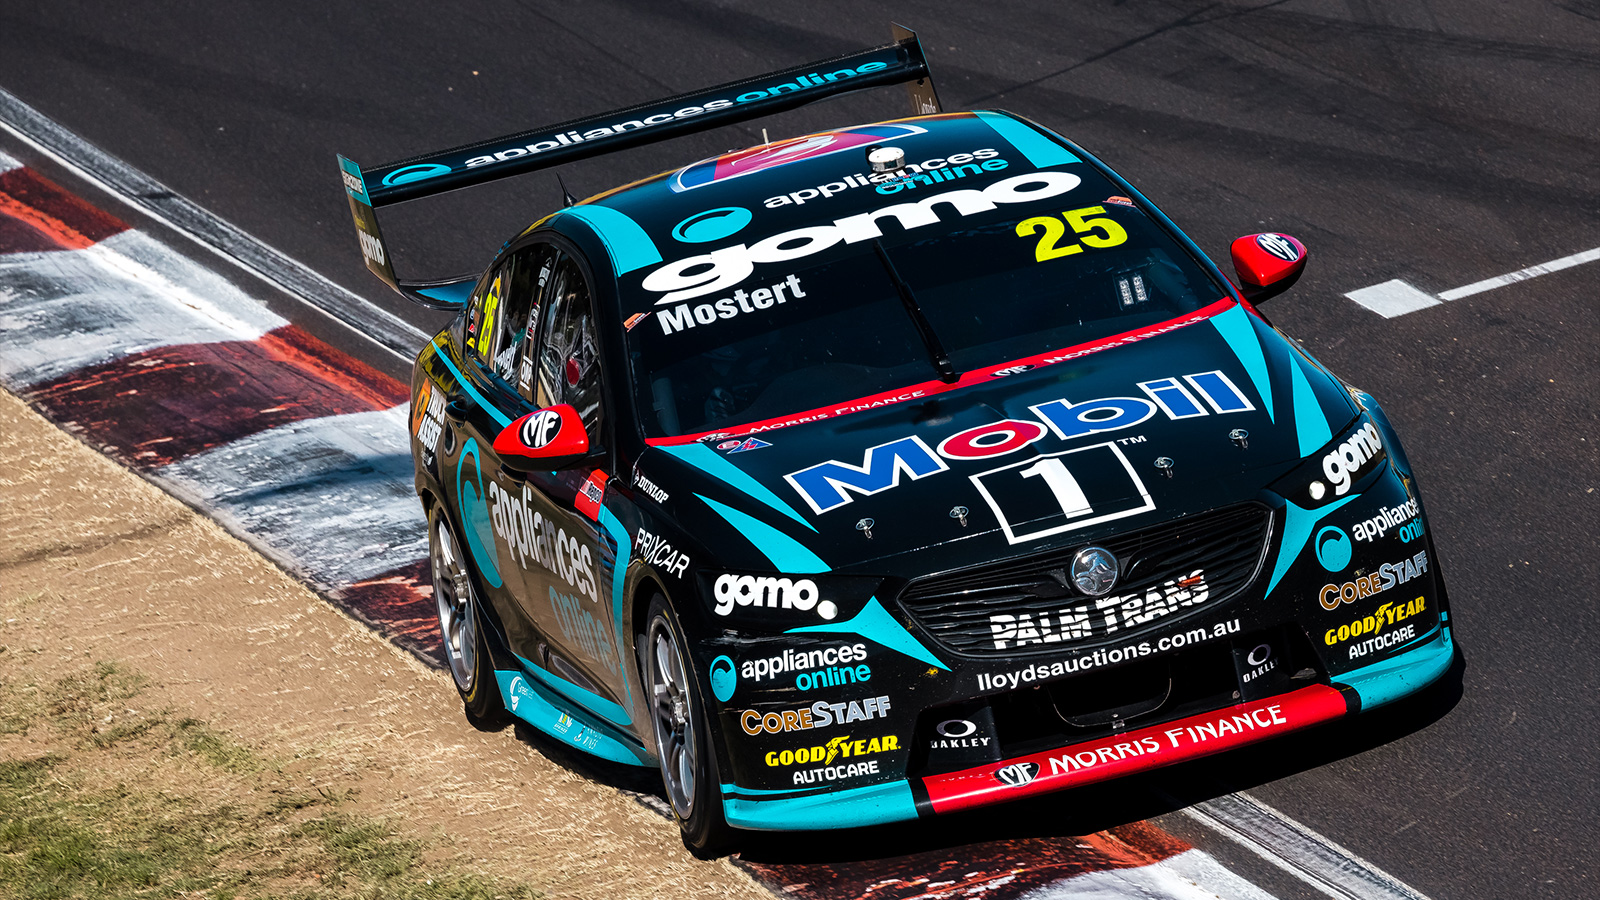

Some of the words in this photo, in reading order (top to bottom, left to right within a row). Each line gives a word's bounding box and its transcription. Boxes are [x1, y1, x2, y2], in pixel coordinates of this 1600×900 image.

[465, 98, 734, 168] appliances
[736, 61, 888, 104] online
[763, 147, 999, 209] appliances
[875, 159, 1009, 195] online
[641, 171, 1082, 306] gomo
[1015, 205, 1128, 262] 25
[656, 274, 807, 336] Mostert
[522, 411, 561, 448] MF
[749, 413, 828, 433] MORRIS
[835, 389, 926, 415] FINANCE
[783, 370, 1255, 515] Mobil
[1322, 422, 1383, 496] gomo
[637, 475, 670, 505] DUNLOP
[1019, 457, 1094, 519] 1
[489, 480, 598, 604] appliances
[1352, 497, 1421, 543] appliance
[635, 527, 690, 579] PRIXCAR
[549, 585, 618, 677] online
[989, 605, 1092, 650] PALM
[1094, 569, 1210, 635] TRANS
[741, 643, 867, 681] appliances
[976, 618, 1242, 692] lloydsauctions.com.au
[1349, 624, 1416, 660] AUTOCARE
[796, 664, 871, 691] online
[1049, 737, 1160, 776] MORRIS
[1164, 704, 1287, 749] FINANCE
[793, 760, 880, 785] AUTOCARE
